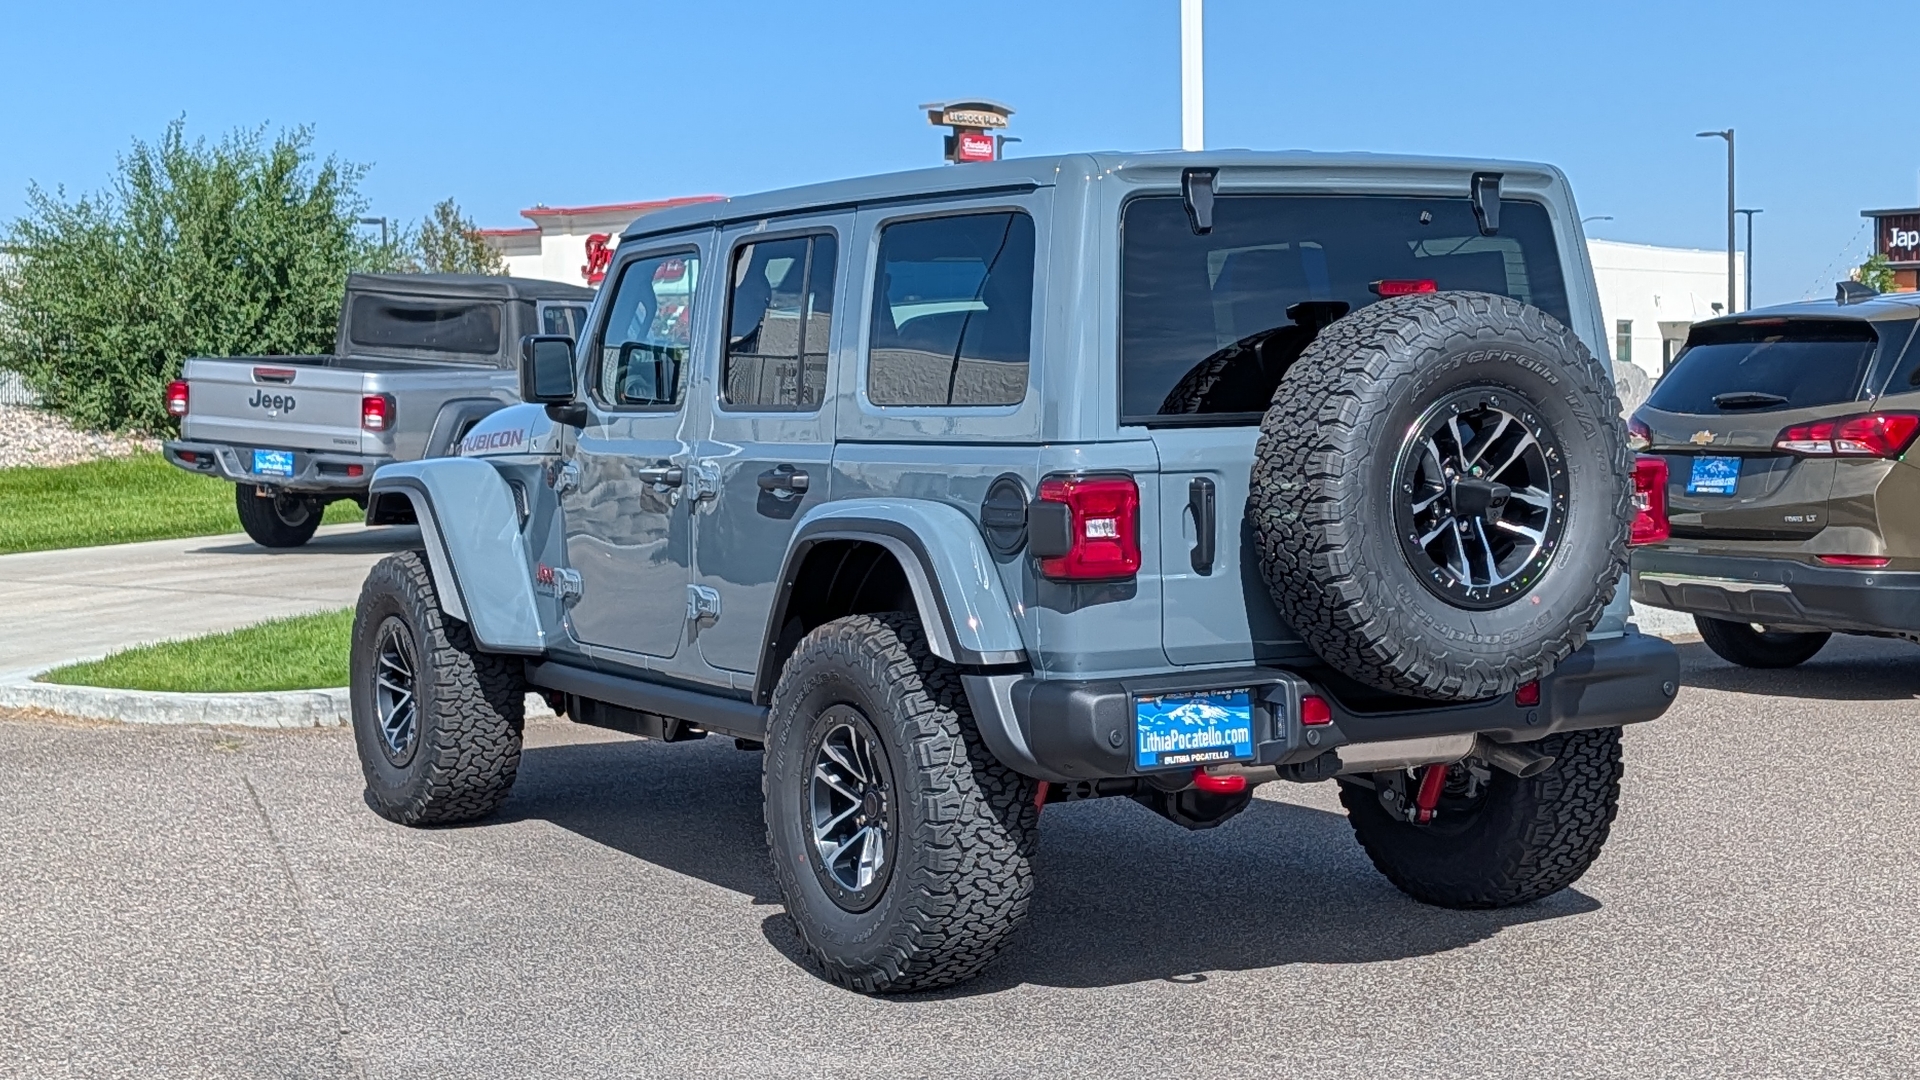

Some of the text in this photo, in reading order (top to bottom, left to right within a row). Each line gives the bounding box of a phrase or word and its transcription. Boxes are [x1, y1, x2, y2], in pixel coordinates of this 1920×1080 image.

[949, 111, 983, 125] BEDROCK
[1889, 227, 1920, 251] Jap
[1410, 349, 1559, 405] All-Terrain
[248, 389, 297, 414] Jeep
[1140, 726, 1249, 753] LithiaPocatello.com
[1191, 751, 1229, 762] POCATELLO
